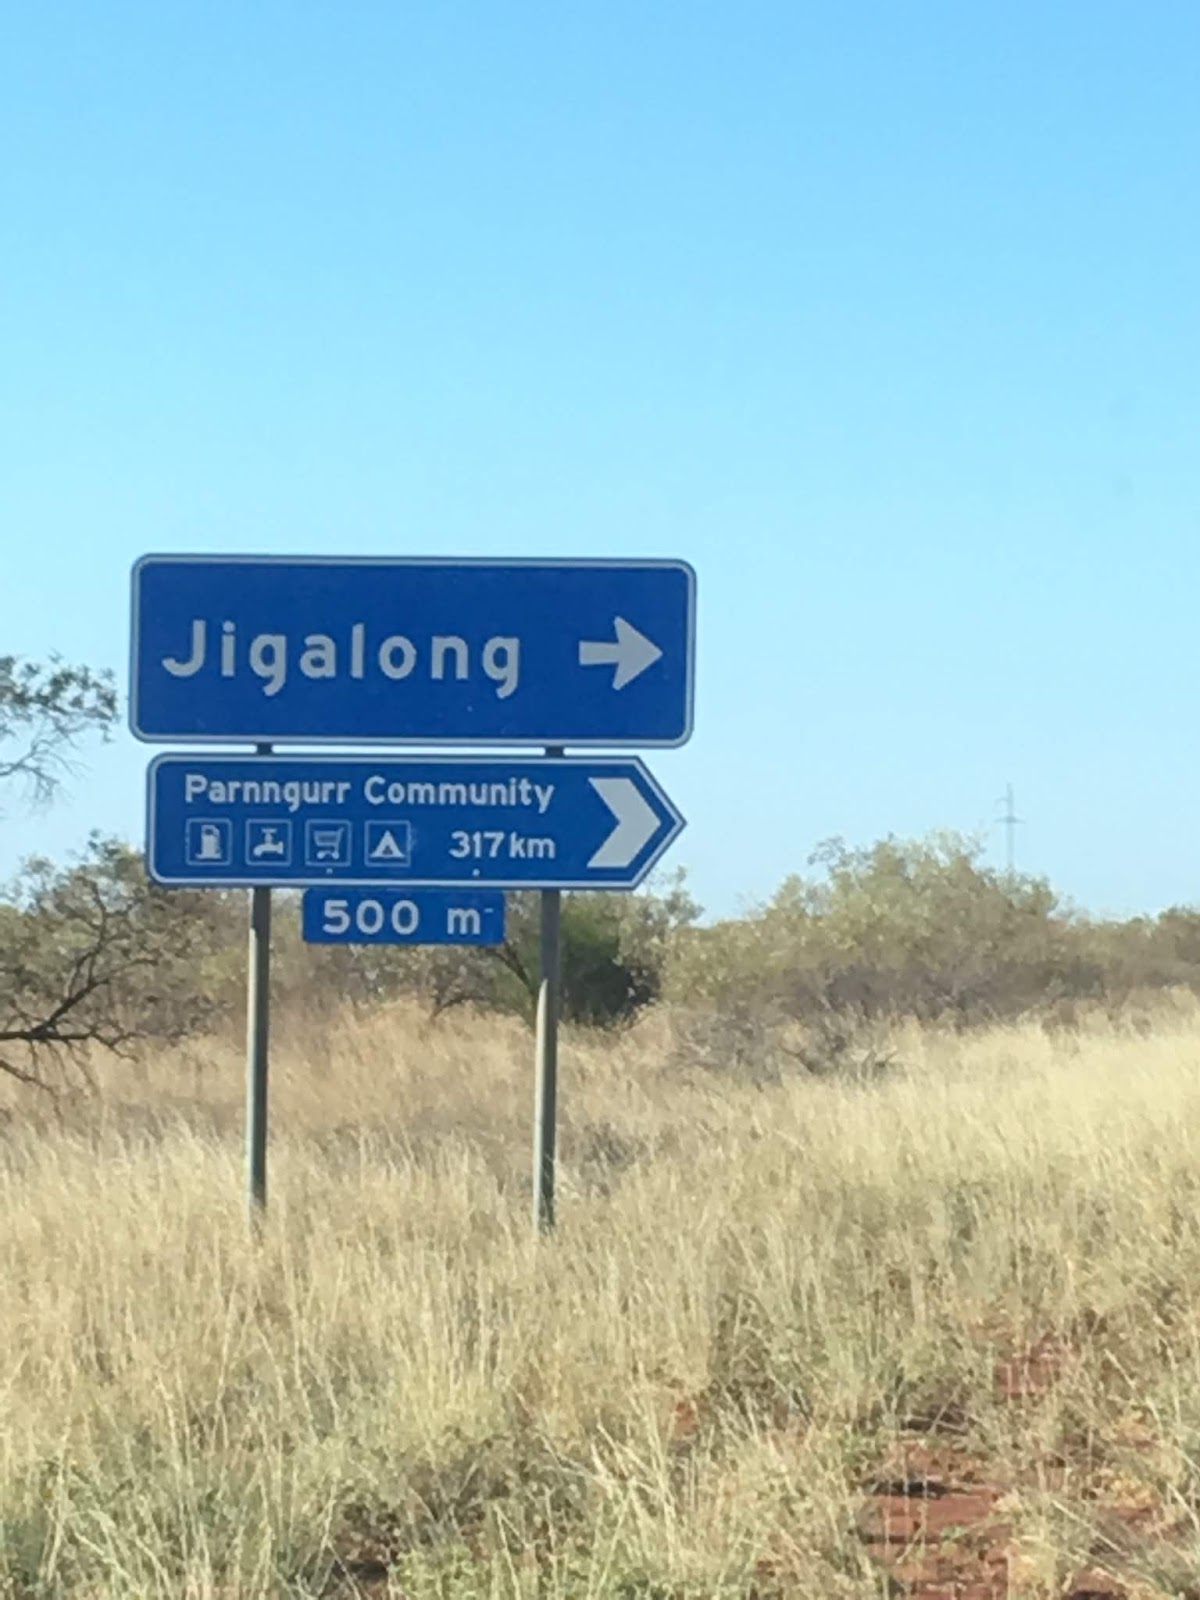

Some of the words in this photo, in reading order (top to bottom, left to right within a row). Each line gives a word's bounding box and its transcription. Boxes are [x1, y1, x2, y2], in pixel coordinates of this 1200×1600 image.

[161, 620, 520, 699] Jigalong
[185, 774, 351, 812] Parnngurr
[364, 775, 555, 812] Community
[322, 899, 419, 935] 500
[446, 908, 482, 935] m
